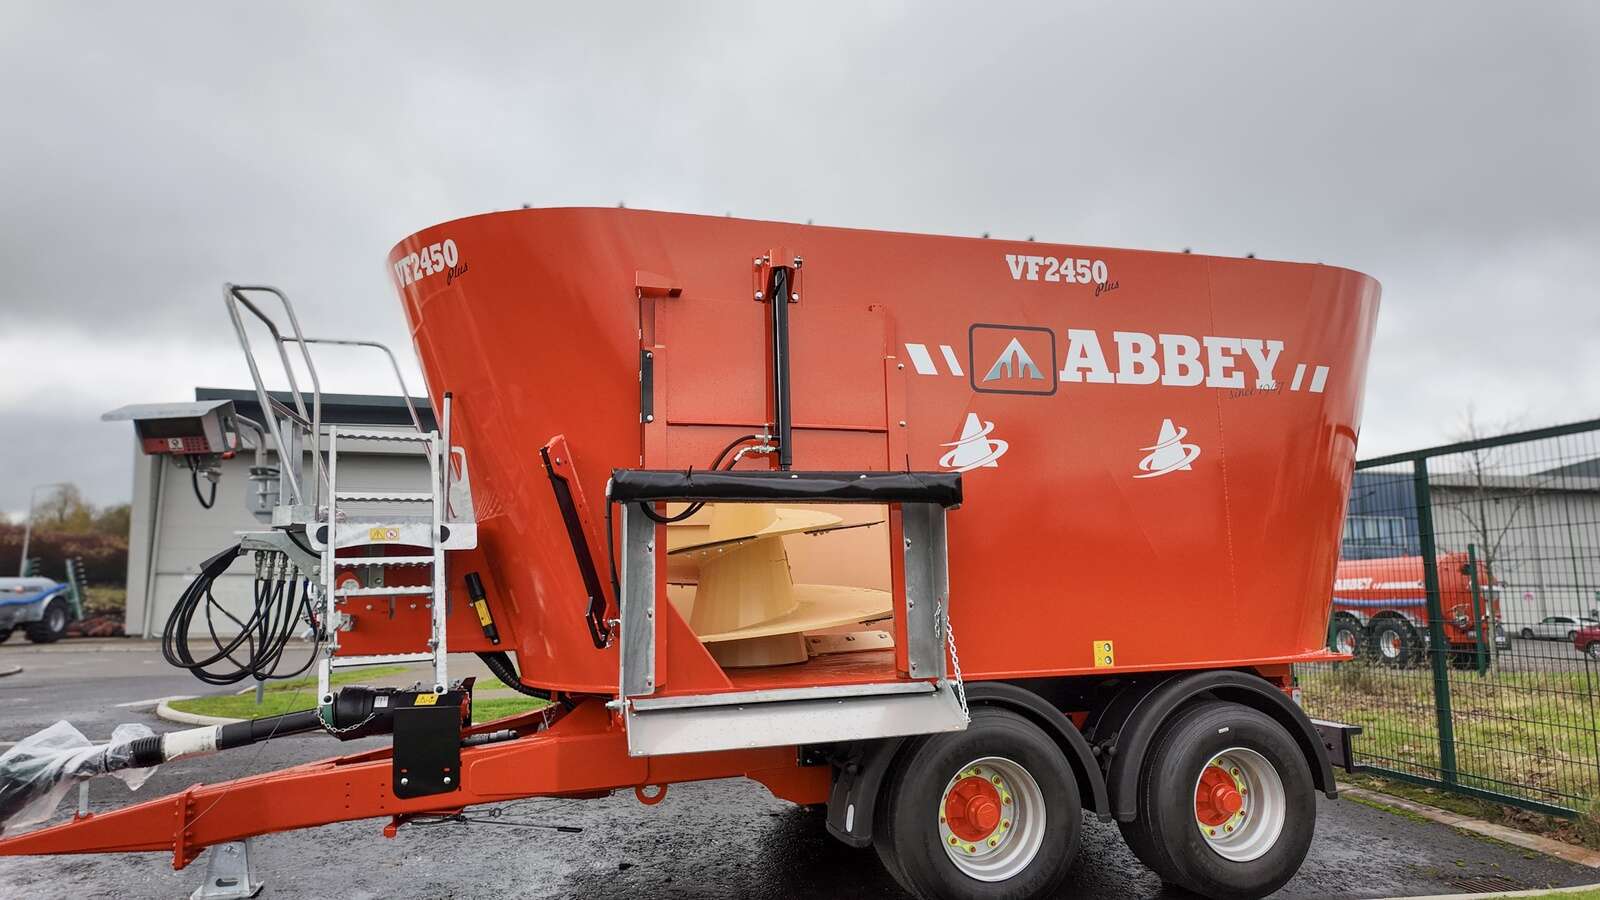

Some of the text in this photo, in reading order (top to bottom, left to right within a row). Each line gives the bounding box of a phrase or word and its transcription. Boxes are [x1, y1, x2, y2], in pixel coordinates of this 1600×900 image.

[394, 239, 458, 288] VF2450
[1005, 254, 1108, 284] VF2450
[1059, 328, 1284, 390] ABBEY
